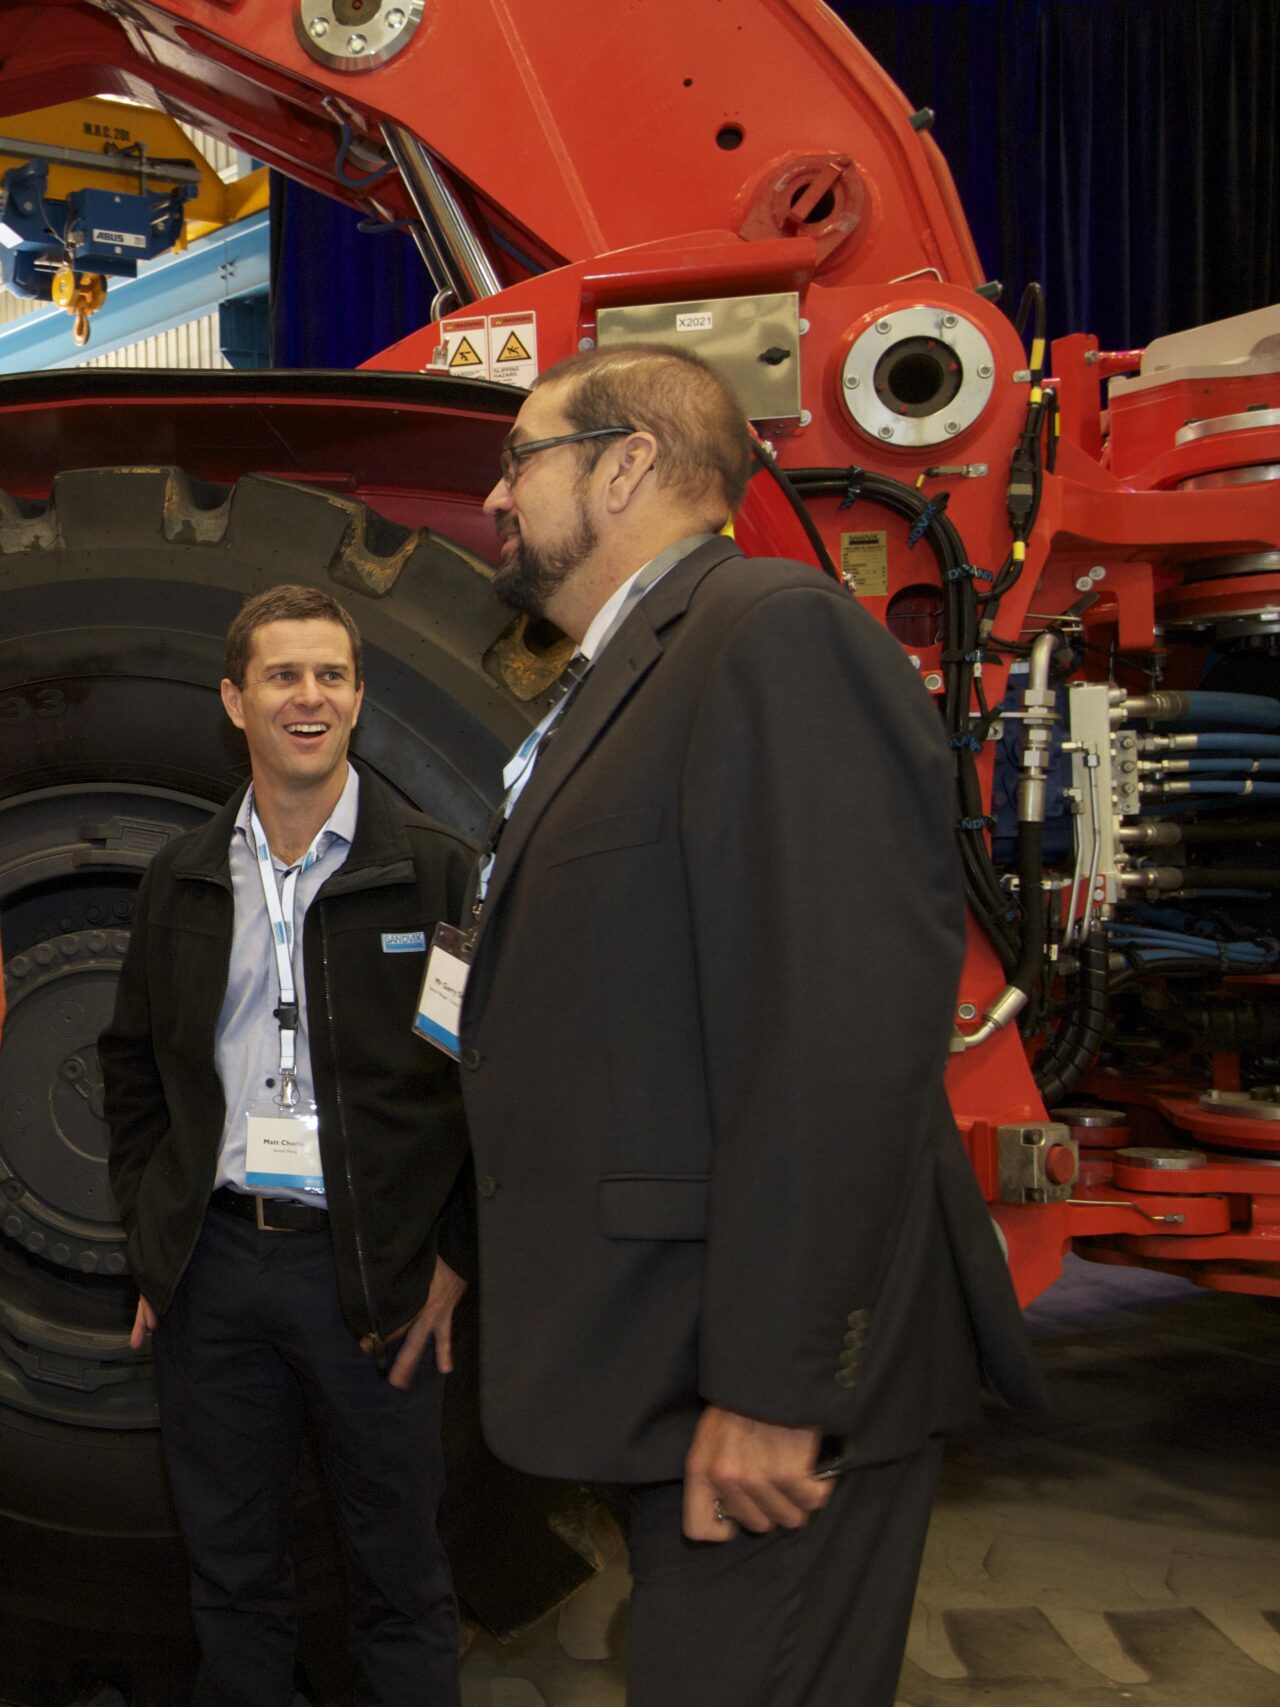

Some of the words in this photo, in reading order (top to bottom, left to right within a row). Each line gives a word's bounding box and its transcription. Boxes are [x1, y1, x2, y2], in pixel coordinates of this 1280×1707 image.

[95, 231, 124, 243] ABUS
[678, 316, 711, 327] X2021
[384, 935, 422, 944] SANDVIK
[263, 1138, 279, 1146] Matt
